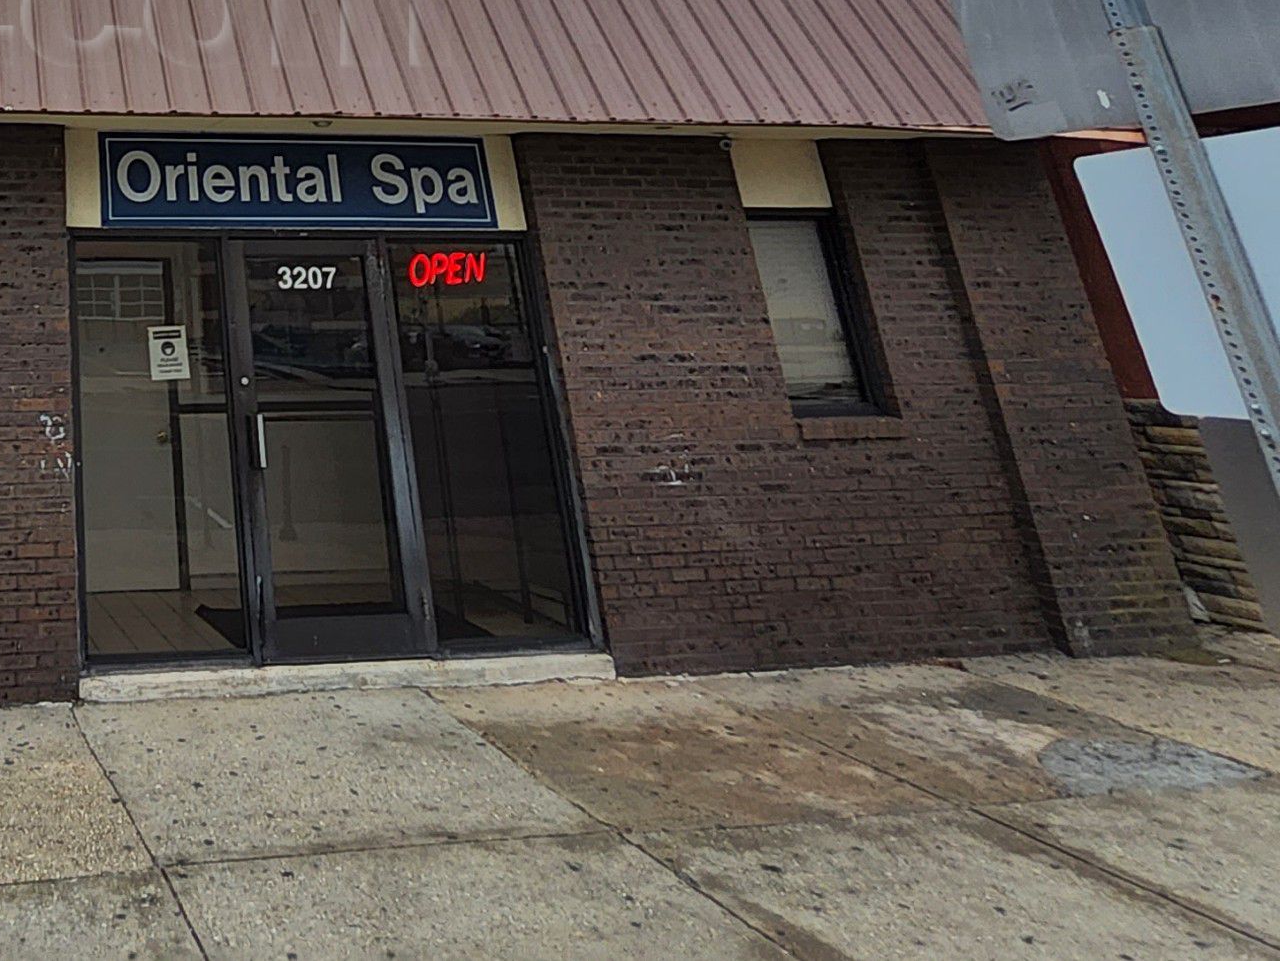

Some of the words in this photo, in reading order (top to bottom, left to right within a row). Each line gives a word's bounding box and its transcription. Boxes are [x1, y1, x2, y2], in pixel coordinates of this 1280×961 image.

[116, 150, 343, 204] Oriental
[371, 153, 480, 214] Spa
[276, 266, 337, 290] 3207
[407, 251, 487, 287] OPEN
